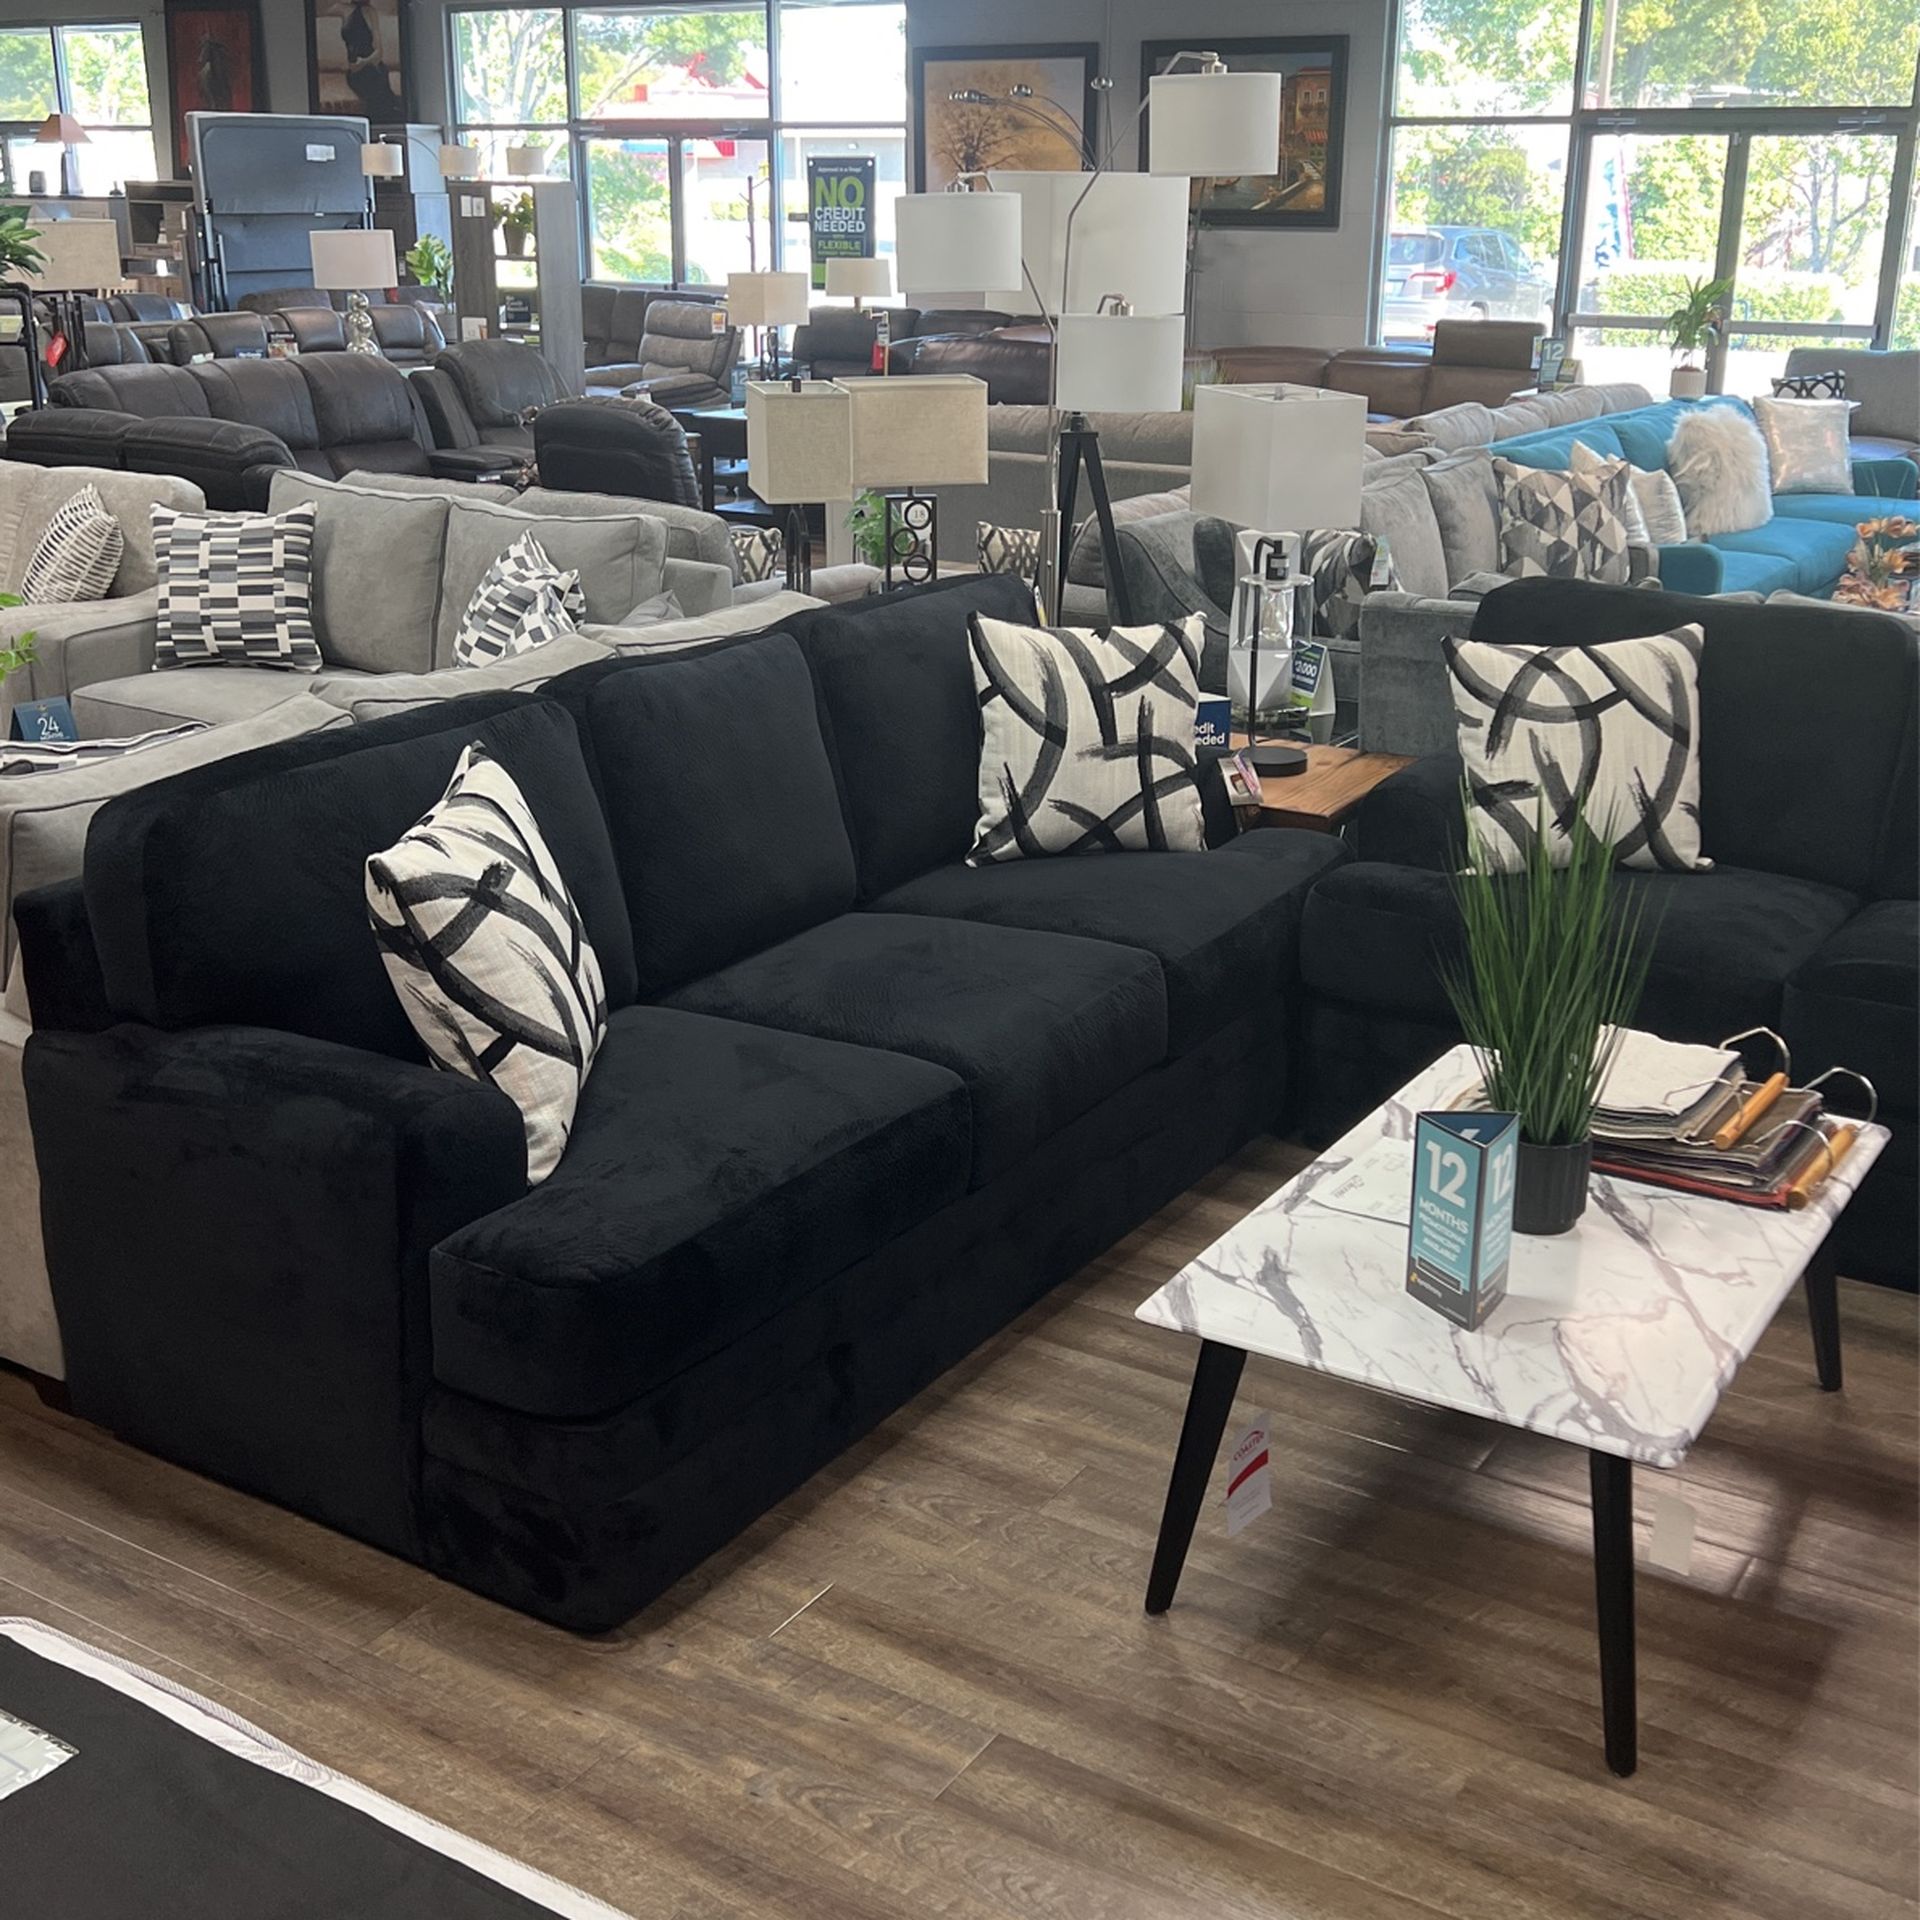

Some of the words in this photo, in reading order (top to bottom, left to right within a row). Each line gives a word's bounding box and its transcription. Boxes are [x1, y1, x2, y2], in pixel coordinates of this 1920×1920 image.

[815, 176, 865, 209] NO
[814, 207, 866, 220] CREDIT
[814, 220, 866, 233] NEEDED
[818, 240, 861, 250] FLEXIBLE
[1543, 342, 1565, 361] 12
[731, 370, 749, 385] 12
[37, 715, 60, 736] 24
[1425, 1140, 1468, 1209] 12
[1491, 1143, 1513, 1205] 12
[1418, 1196, 1470, 1235] MONTHS
